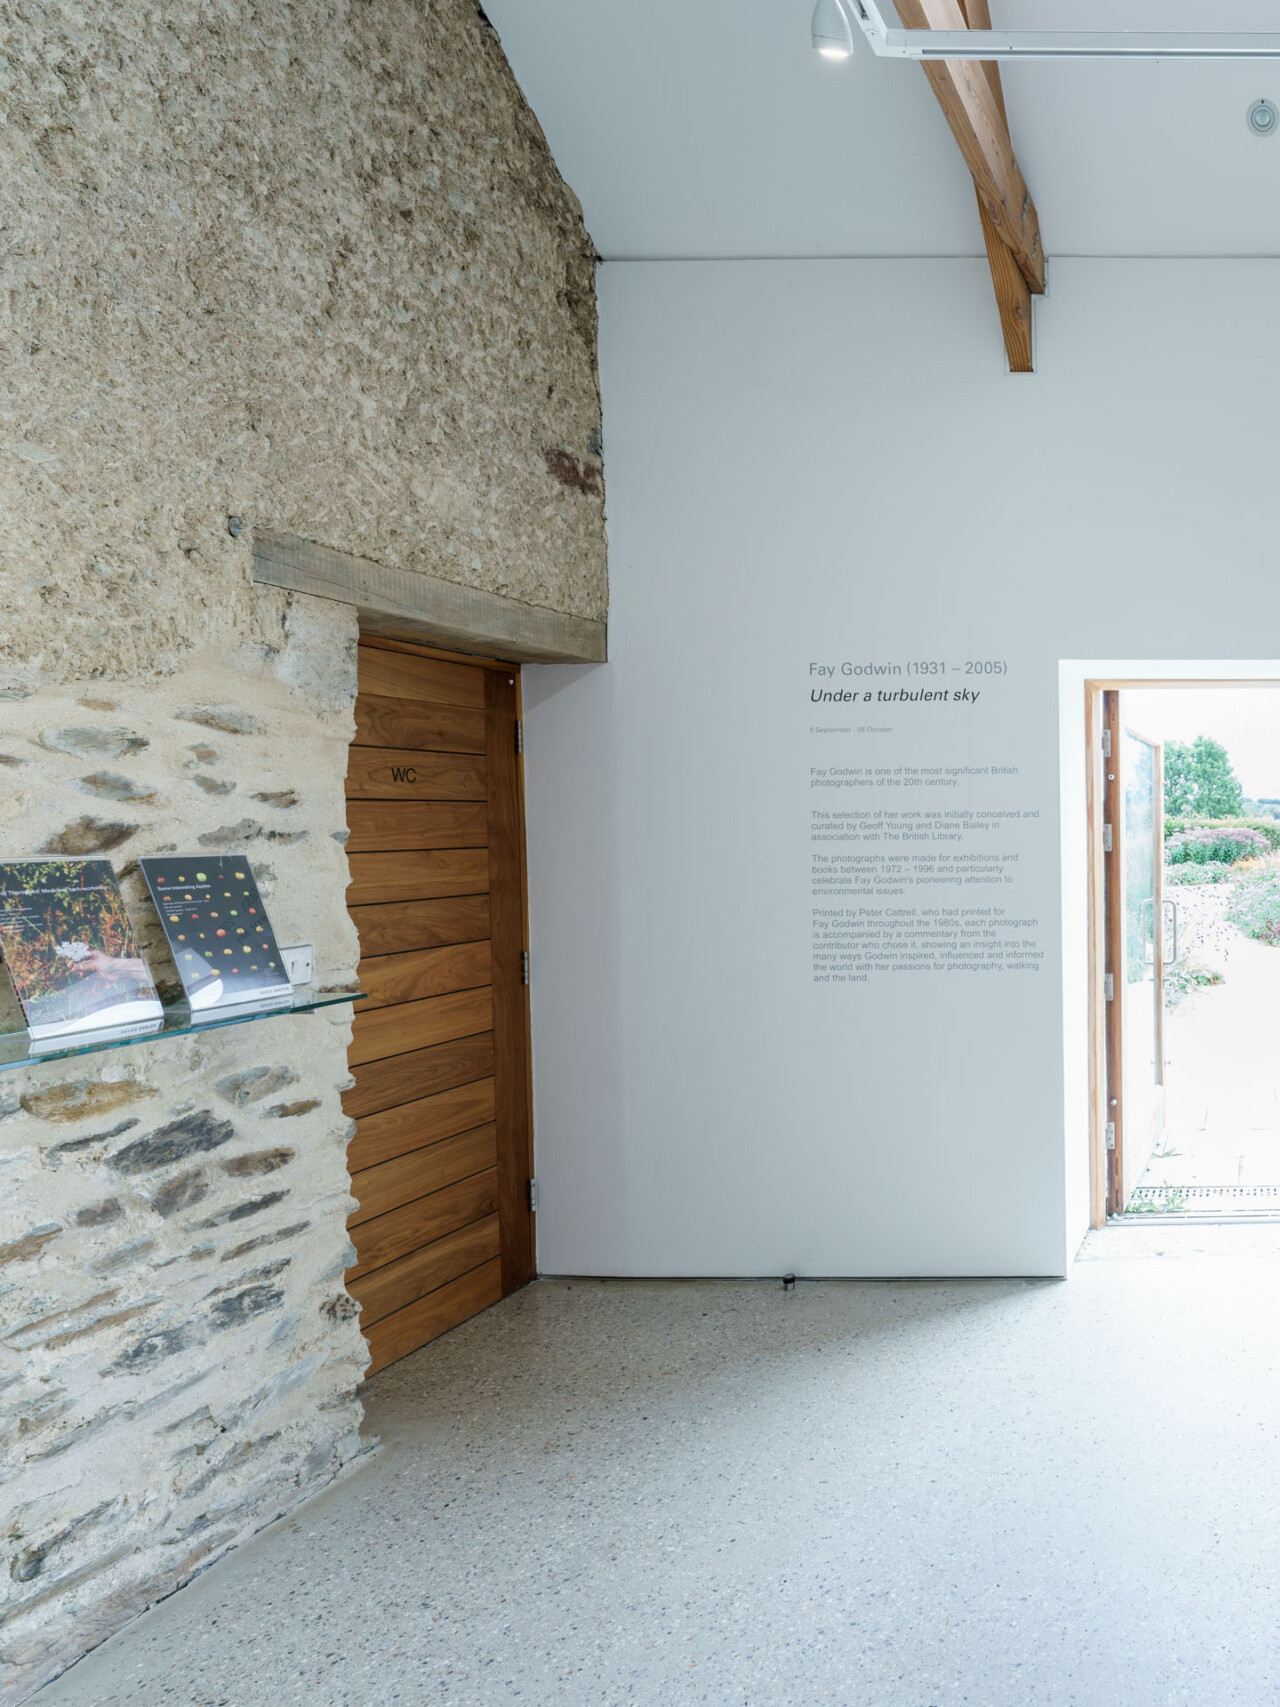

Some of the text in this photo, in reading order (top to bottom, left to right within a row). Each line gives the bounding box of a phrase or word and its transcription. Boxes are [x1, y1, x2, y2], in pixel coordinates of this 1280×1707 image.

[809, 663, 835, 680] Fay
[841, 662, 902, 675] Godwin
[907, 662, 945, 679] (1931
[965, 661, 1008, 678] 2005)
[810, 688, 980, 704] Under a turbulent sky
[391, 767, 417, 783] WC
[810, 767, 827, 777] Fay
[829, 767, 863, 775] Godwin
[865, 767, 873, 775] is
[893, 766, 903, 775] of
[904, 766, 919, 775] the
[920, 766, 942, 774] most
[944, 766, 989, 776] significant
[991, 765, 1019, 774] British
[810, 778, 874, 788] photographers
[876, 777, 885, 786] of
[886, 777, 901, 786] the
[903, 777, 923, 785] 20th
[810, 810, 830, 819] This
[832, 810, 871, 819] selection
[873, 810, 882, 818] of
[884, 810, 898, 818] her
[900, 810, 922, 818] work
[944, 809, 974, 820] initially
[976, 809, 1020, 817] conceived
[1022, 809, 1040, 817] and
[810, 820, 1000, 832] curated by Geoff Young and Diane Bailey in
[810, 832, 860, 840] association
[862, 832, 880, 840] with
[883, 832, 900, 840] The
[902, 831, 930, 840] British
[811, 854, 829, 862] The
[831, 854, 886, 864] photographs
[912, 853, 937, 862] made
[938, 853, 951, 861] for
[952, 853, 1000, 861] exhibitions
[1002, 853, 1019, 861] and
[811, 865, 838, 873] books
[840, 865, 878, 873] between
[881, 864, 902, 873] 1972
[914, 864, 935, 872] 1996
[937, 864, 954, 872] and
[956, 864, 1004, 874] particularly
[811, 874, 1013, 886] celebrate Fay Godwin's pioneering attention to
[811, 886, 874, 895] environmental
[812, 908, 844, 917] Printed
[846, 908, 857, 919] by
[859, 908, 883, 916] Peter
[921, 907, 940, 916] who
[942, 907, 959, 916] had
[961, 907, 991, 918] printed
[993, 907, 1006, 915] for
[812, 919, 829, 930] Fay
[831, 919, 865, 927] Godwin
[867, 919, 914, 929] throughout
[916, 918, 930, 927] the
[964, 918, 986, 926] each
[988, 918, 1038, 928] photograph
[812, 930, 820, 938] is
[822, 930, 881, 940] accompanied
[883, 929, 894, 940] by
[904, 929, 958, 940] commentary
[960, 929, 981, 937] from
[982, 929, 997, 937] the
[812, 941, 860, 949] contributor
[861, 940, 880, 949] who
[882, 940, 908, 948] chose
[921, 940, 957, 950] showing
[973, 939, 1002, 950] insight
[1004, 939, 1020, 947] into
[1022, 939, 1036, 947] the
[812, 953, 837, 962] many
[839, 953, 862, 962] ways
[864, 951, 898, 959] Godwin
[940, 950, 984, 959] influenced
[987, 950, 1004, 958] and
[1006, 950, 1044, 958] informed
[812, 962, 827, 971] the
[829, 962, 853, 970] world
[855, 962, 873, 970] with
[875, 962, 890, 970] her
[892, 962, 931, 972] passions
[933, 961, 945, 970] for
[1006, 961, 1040, 971] walking
[812, 973, 830, 982] and
[832, 973, 846, 981] the
